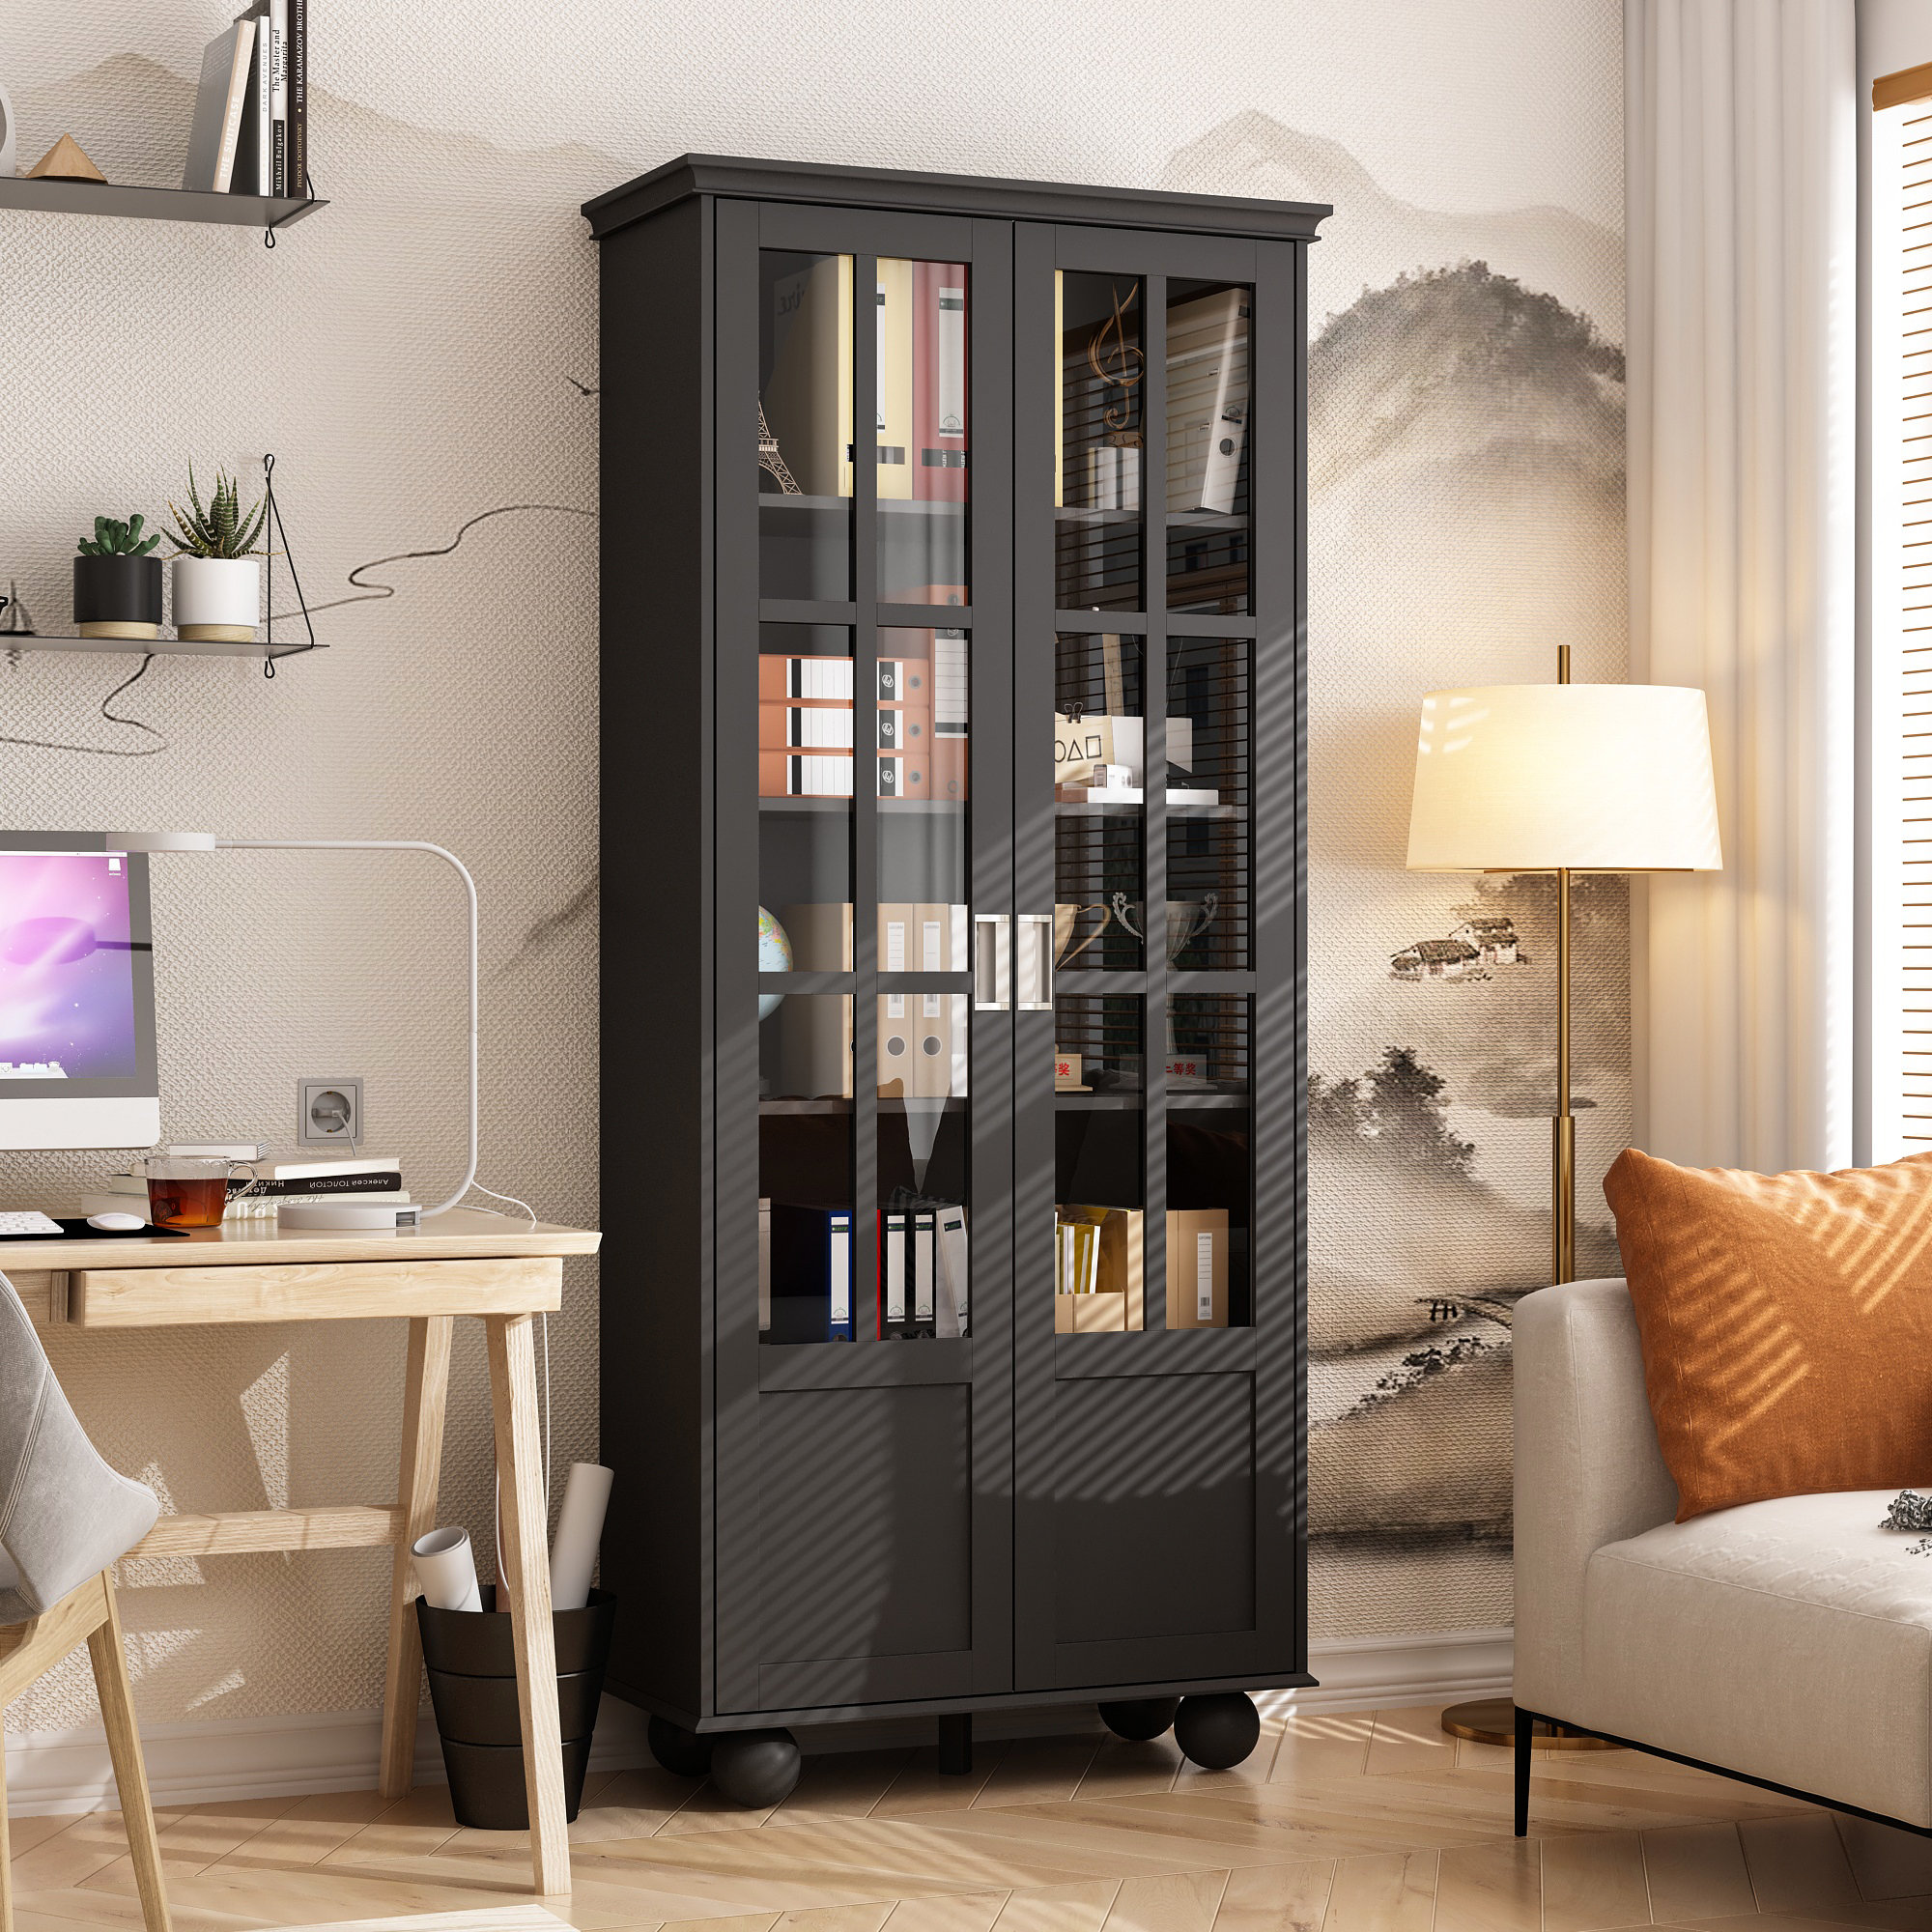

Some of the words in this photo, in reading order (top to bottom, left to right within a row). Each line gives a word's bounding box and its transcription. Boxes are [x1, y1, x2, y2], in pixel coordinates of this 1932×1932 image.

[224, 96, 241, 154] SUITCASE
[219, 156, 230, 179] THE
[309, 1179, 350, 1189] ТОЛСТОЙ
[352, 1178, 389, 1186] Алексей
